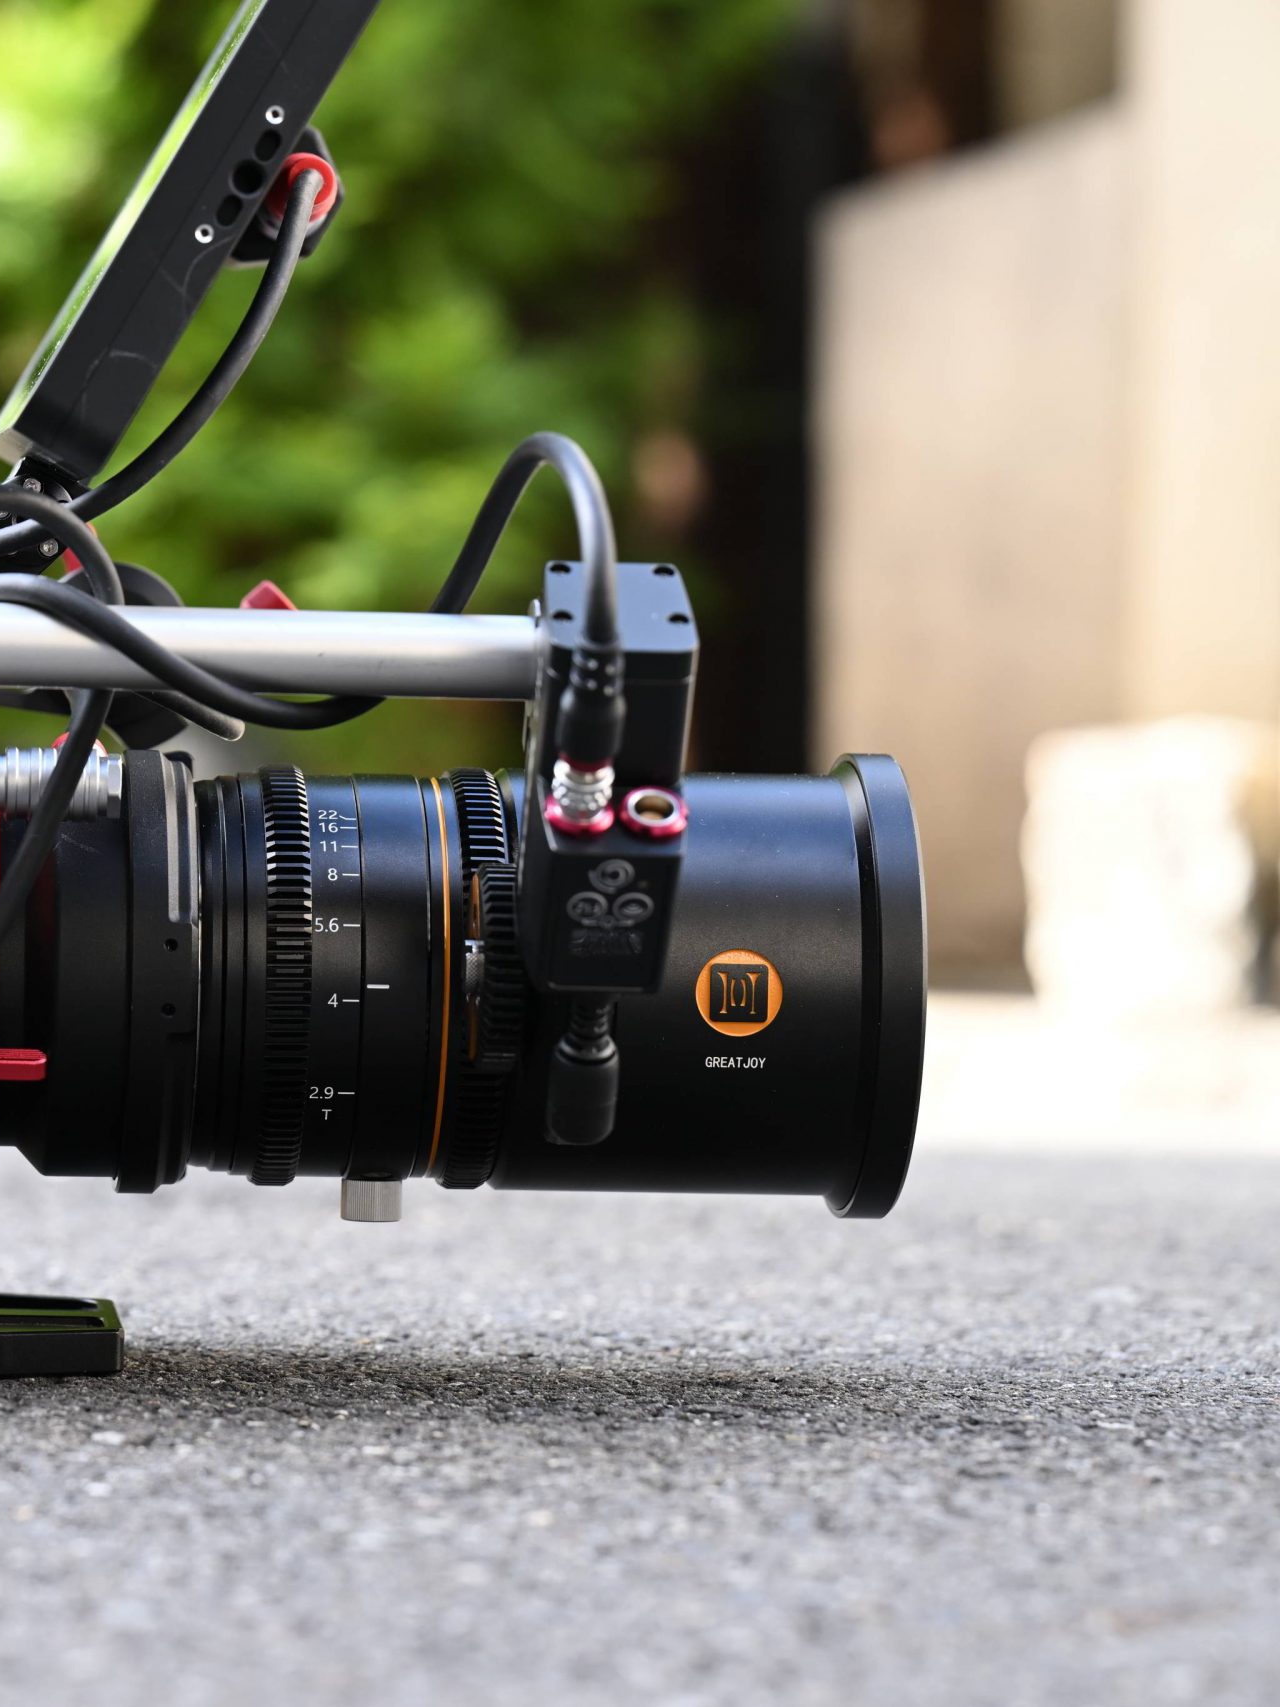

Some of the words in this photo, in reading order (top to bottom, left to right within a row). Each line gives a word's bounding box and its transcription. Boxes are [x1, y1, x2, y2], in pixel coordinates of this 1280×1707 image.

[318, 809, 338, 820] 22
[319, 822, 339, 833] 16
[320, 840, 337, 852] 11
[327, 868, 338, 881] 8
[314, 917, 339, 932] 5.6
[327, 993, 338, 1008] 4
[705, 1056, 766, 1069] GREATJOY
[309, 1086, 334, 1099] 2.9
[321, 1108, 332, 1120] T
